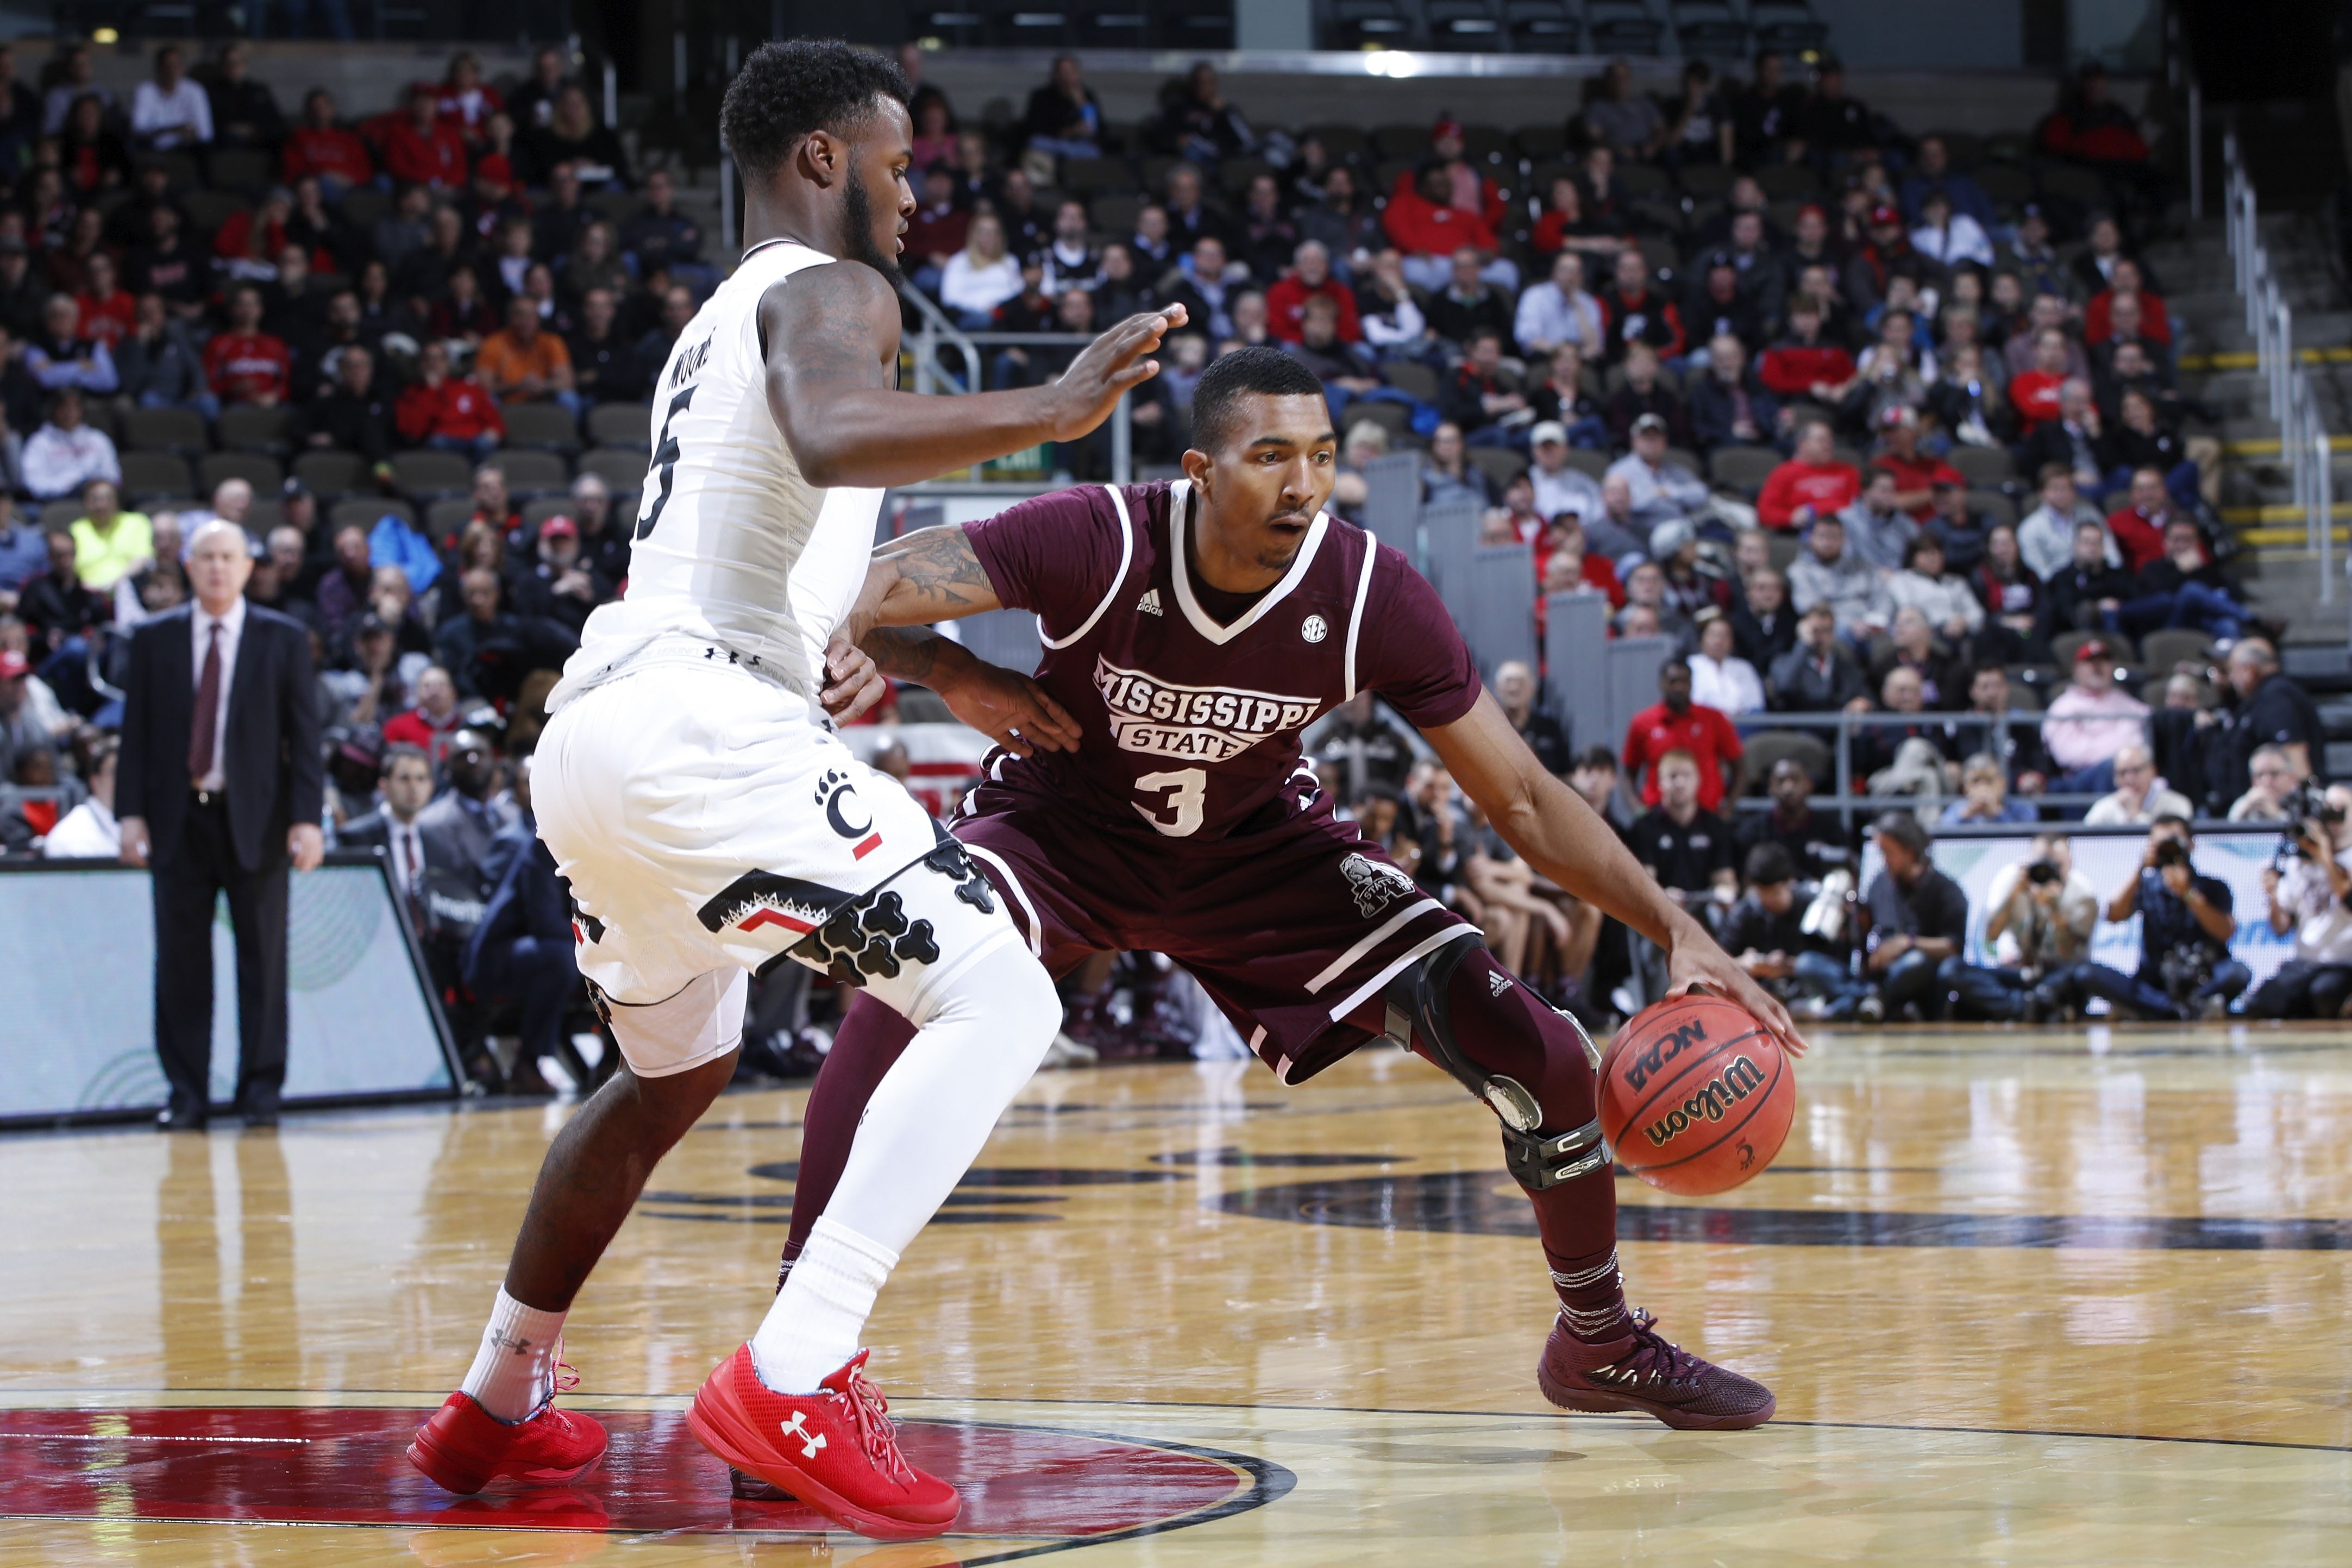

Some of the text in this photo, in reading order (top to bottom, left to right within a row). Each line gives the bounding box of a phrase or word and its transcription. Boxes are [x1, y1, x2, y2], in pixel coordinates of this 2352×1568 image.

[636, 382, 699, 541] 5
[1303, 617, 1326, 641] SEC
[1093, 657, 1320, 732] MISSISSIPPI
[1131, 729, 1239, 759] STATE
[1131, 767, 1206, 837] 3
[1364, 877, 1395, 900] STATE
[1492, 979, 1513, 998] adidas
[1623, 1019, 1708, 1094] NCAA
[1642, 1053, 1766, 1147] Wilson
